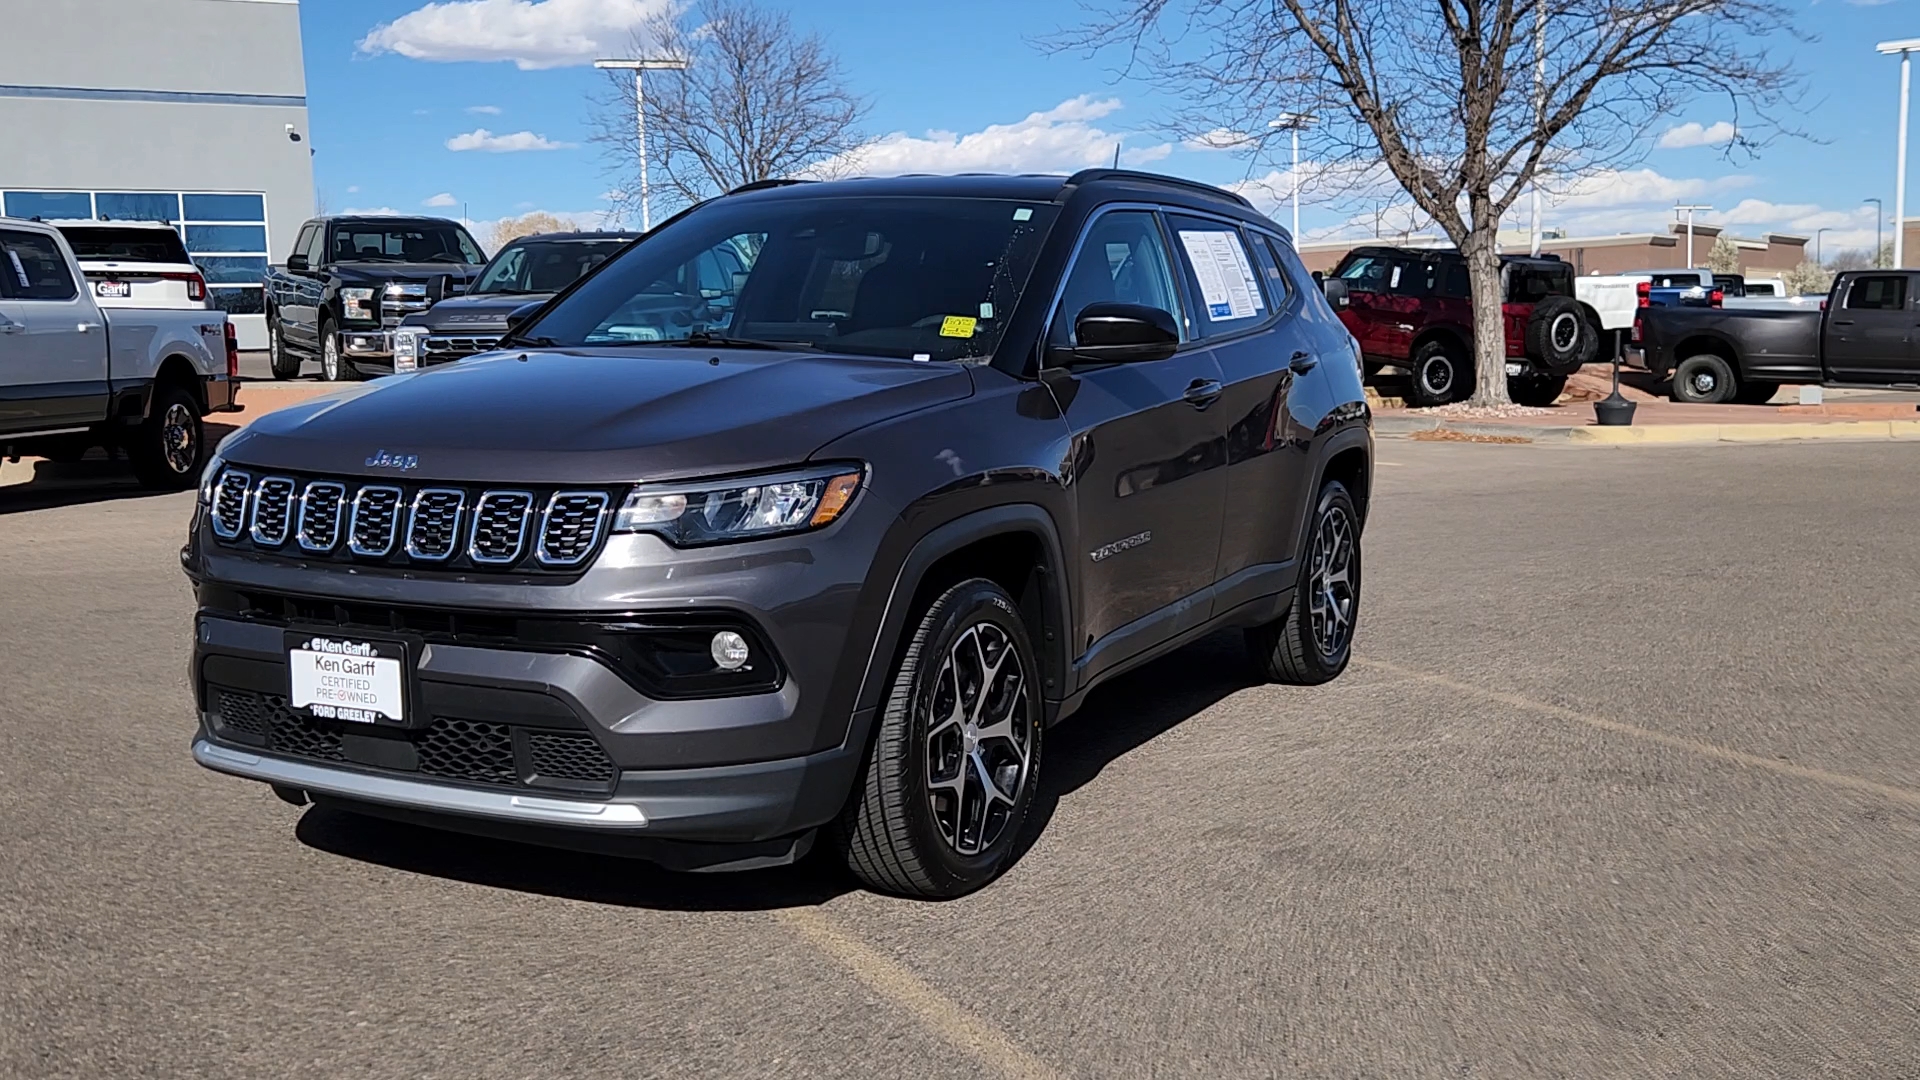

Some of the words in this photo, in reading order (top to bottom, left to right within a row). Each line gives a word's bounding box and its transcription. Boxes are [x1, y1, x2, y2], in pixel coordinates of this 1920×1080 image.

[365, 449, 418, 472] Jeep
[320, 638, 342, 653] Ken
[342, 640, 371, 657] Garff
[315, 655, 340, 672] Ken
[342, 658, 376, 676] Garff
[321, 675, 371, 691] CERTIFIED
[313, 704, 336, 718] FORD
[337, 707, 376, 723] GREELEY
